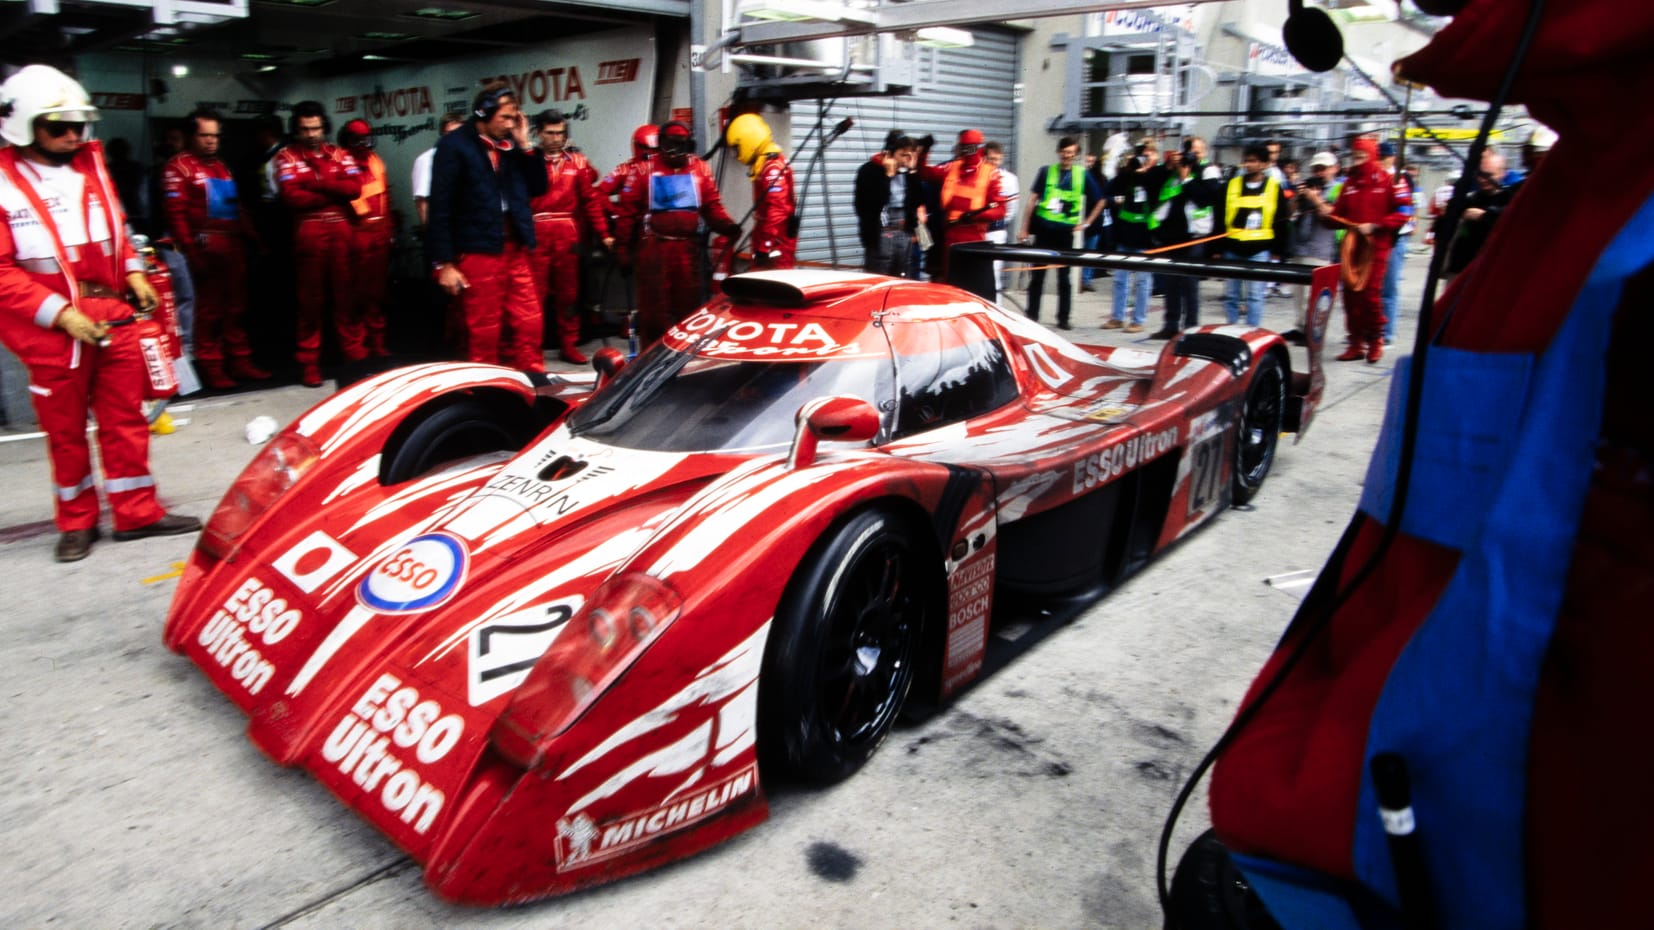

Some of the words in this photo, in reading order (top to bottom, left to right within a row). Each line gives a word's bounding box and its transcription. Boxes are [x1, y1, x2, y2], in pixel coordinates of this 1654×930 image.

[360, 86, 435, 118] TOYOTA
[481, 66, 586, 106] YOTA
[681, 307, 837, 346] TOYOTA
[487, 474, 580, 515] ZENRIN
[1073, 443, 1125, 495] ESSO
[1126, 426, 1178, 468] Ultron
[223, 576, 302, 645] ESSO
[950, 594, 989, 629] BOSCH
[198, 608, 276, 696] Ultron
[351, 672, 465, 765] ESSO
[322, 712, 446, 836] Ultron
[600, 770, 752, 849] MICHELIN
